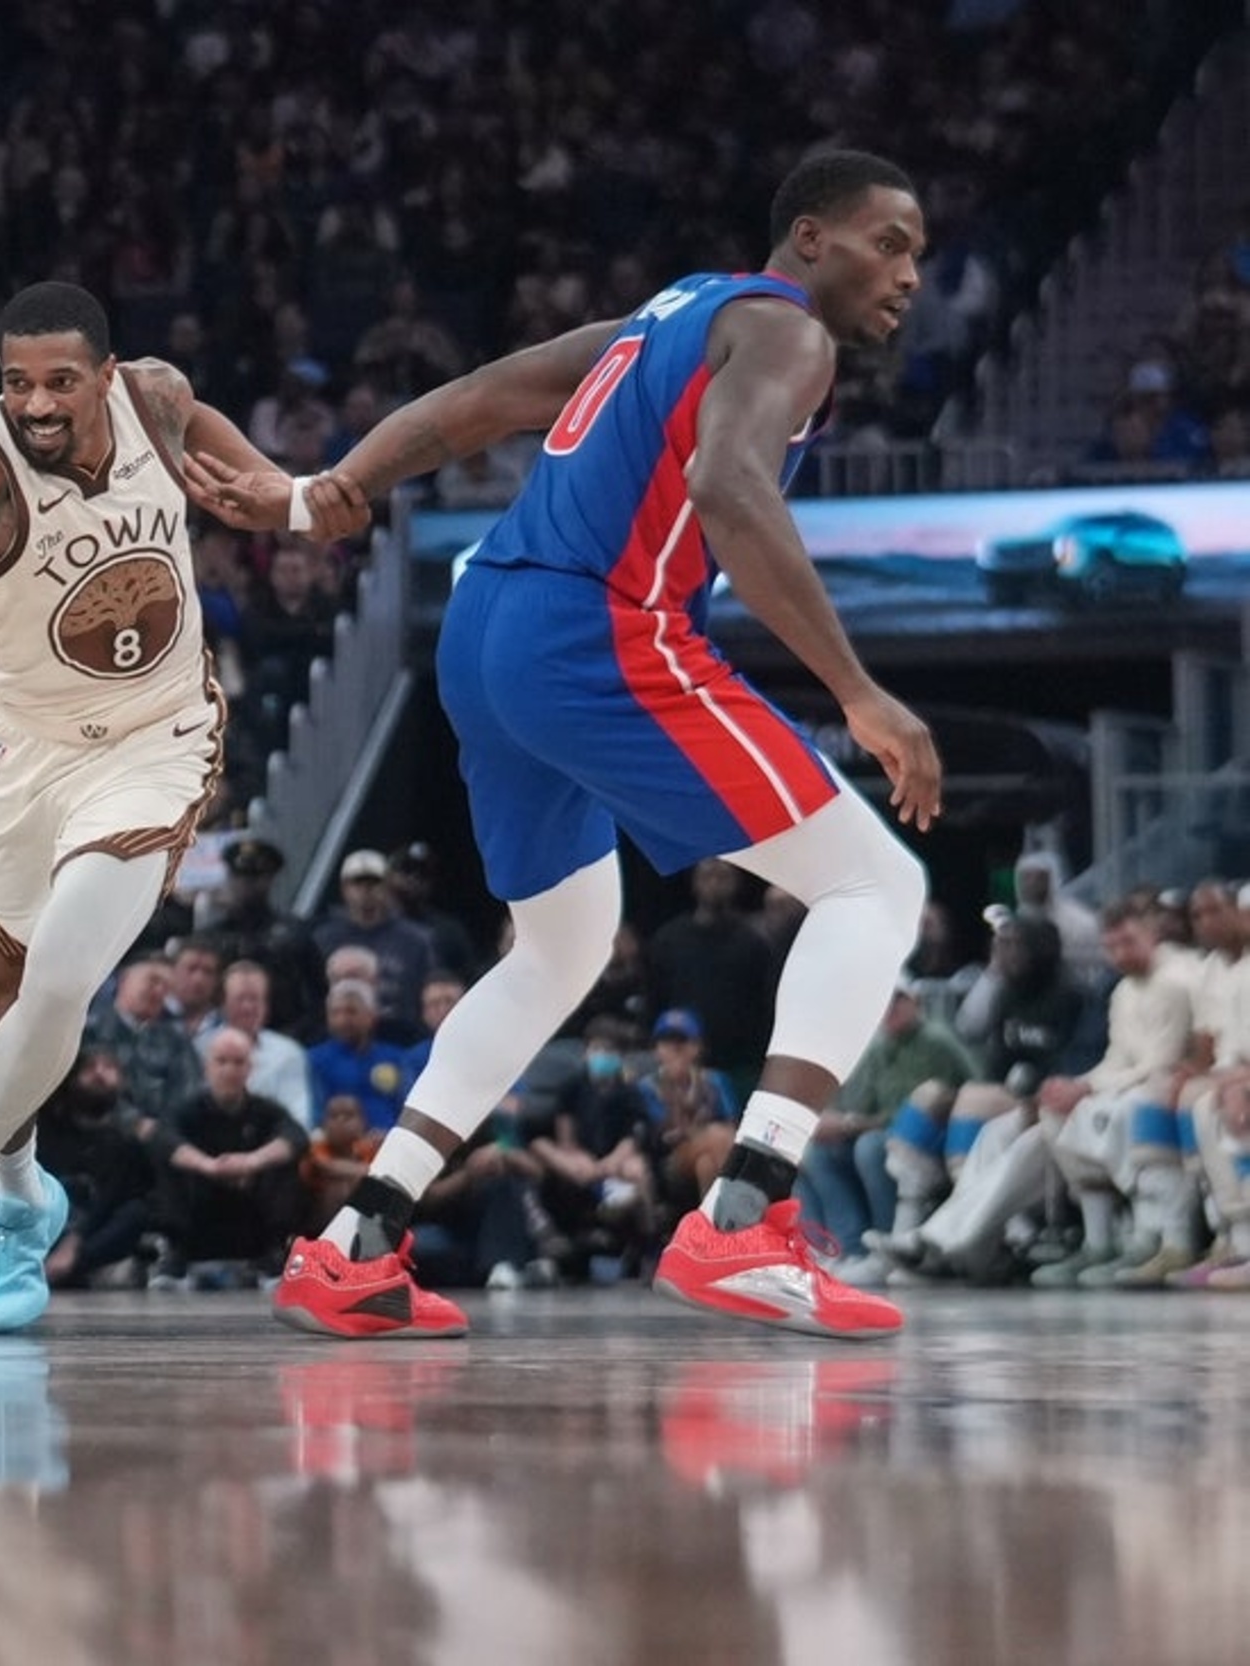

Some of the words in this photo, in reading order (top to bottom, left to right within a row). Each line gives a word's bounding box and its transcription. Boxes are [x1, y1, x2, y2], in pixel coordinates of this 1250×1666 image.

[543, 333, 645, 456] 0
[34, 507, 178, 586] TOWN
[113, 628, 142, 667] 8
